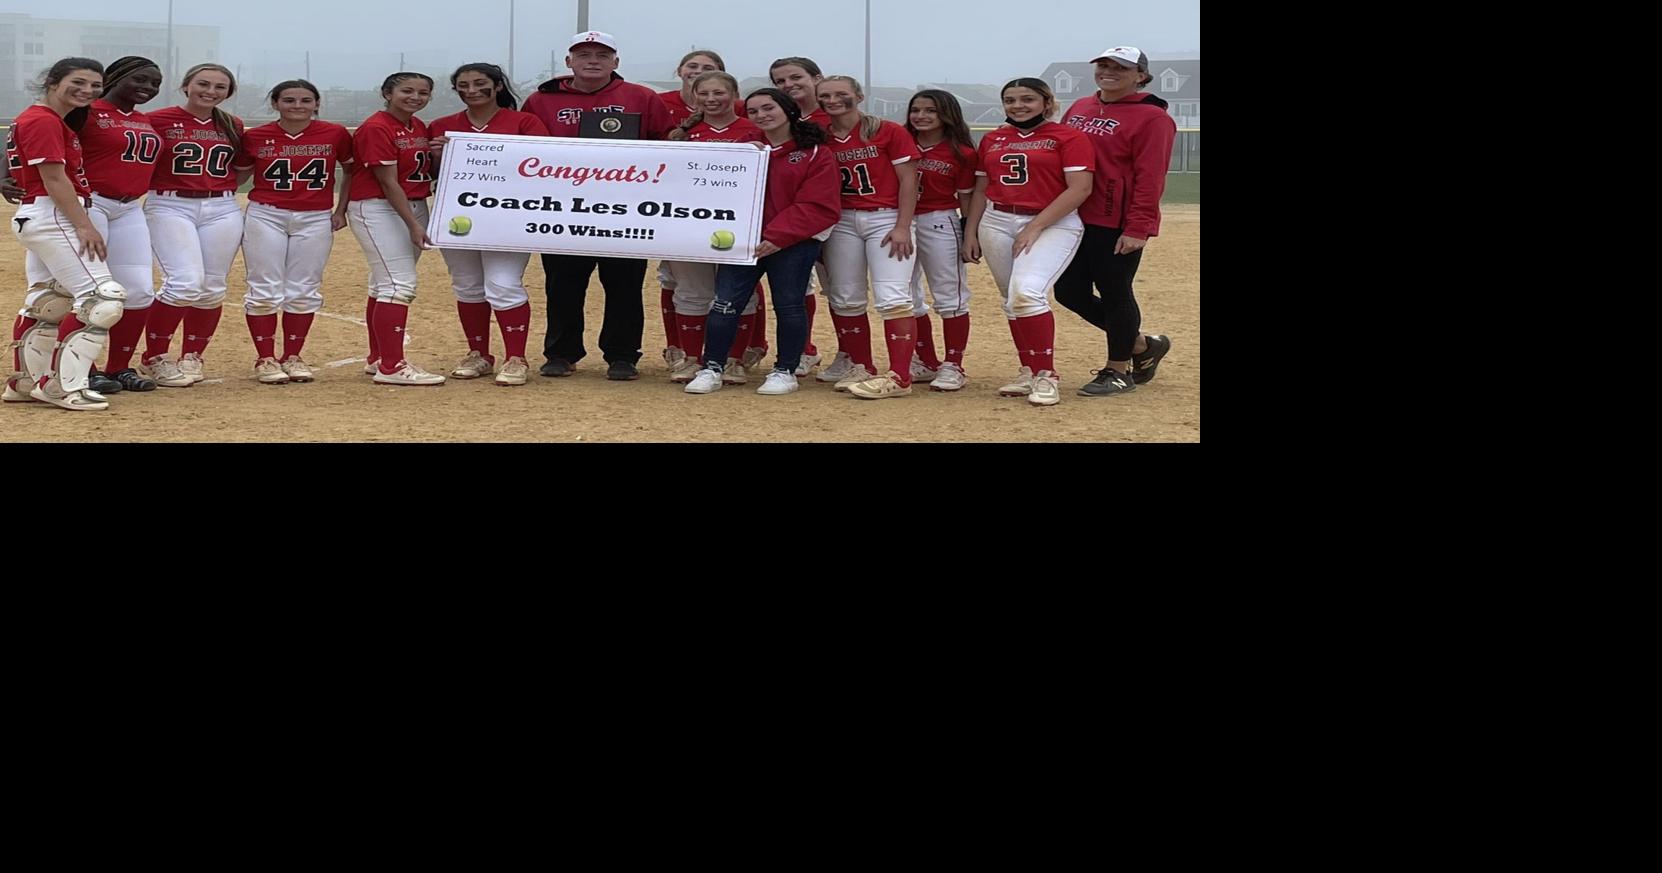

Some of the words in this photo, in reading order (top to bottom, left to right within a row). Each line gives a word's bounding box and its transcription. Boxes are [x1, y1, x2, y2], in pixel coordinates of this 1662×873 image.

[121, 130, 162, 164] 10
[172, 141, 235, 178] 20
[279, 144, 333, 157] JOSEPH
[465, 142, 505, 153] Sacred
[466, 156, 498, 167] Heart
[517, 156, 667, 187] Congrats!
[687, 161, 702, 172] St.
[704, 161, 747, 174] Joseph
[1000, 153, 1029, 186] 3
[263, 158, 329, 191] 44
[452, 171, 475, 182] 227
[477, 172, 506, 183] Wins
[692, 176, 708, 188] 73
[710, 178, 739, 189] wins
[839, 163, 876, 196] 21
[457, 191, 563, 212] Coach
[570, 197, 628, 216] Les
[636, 200, 737, 222] Olson
[524, 222, 565, 235] 300
[567, 224, 656, 241] Wins!!!!
